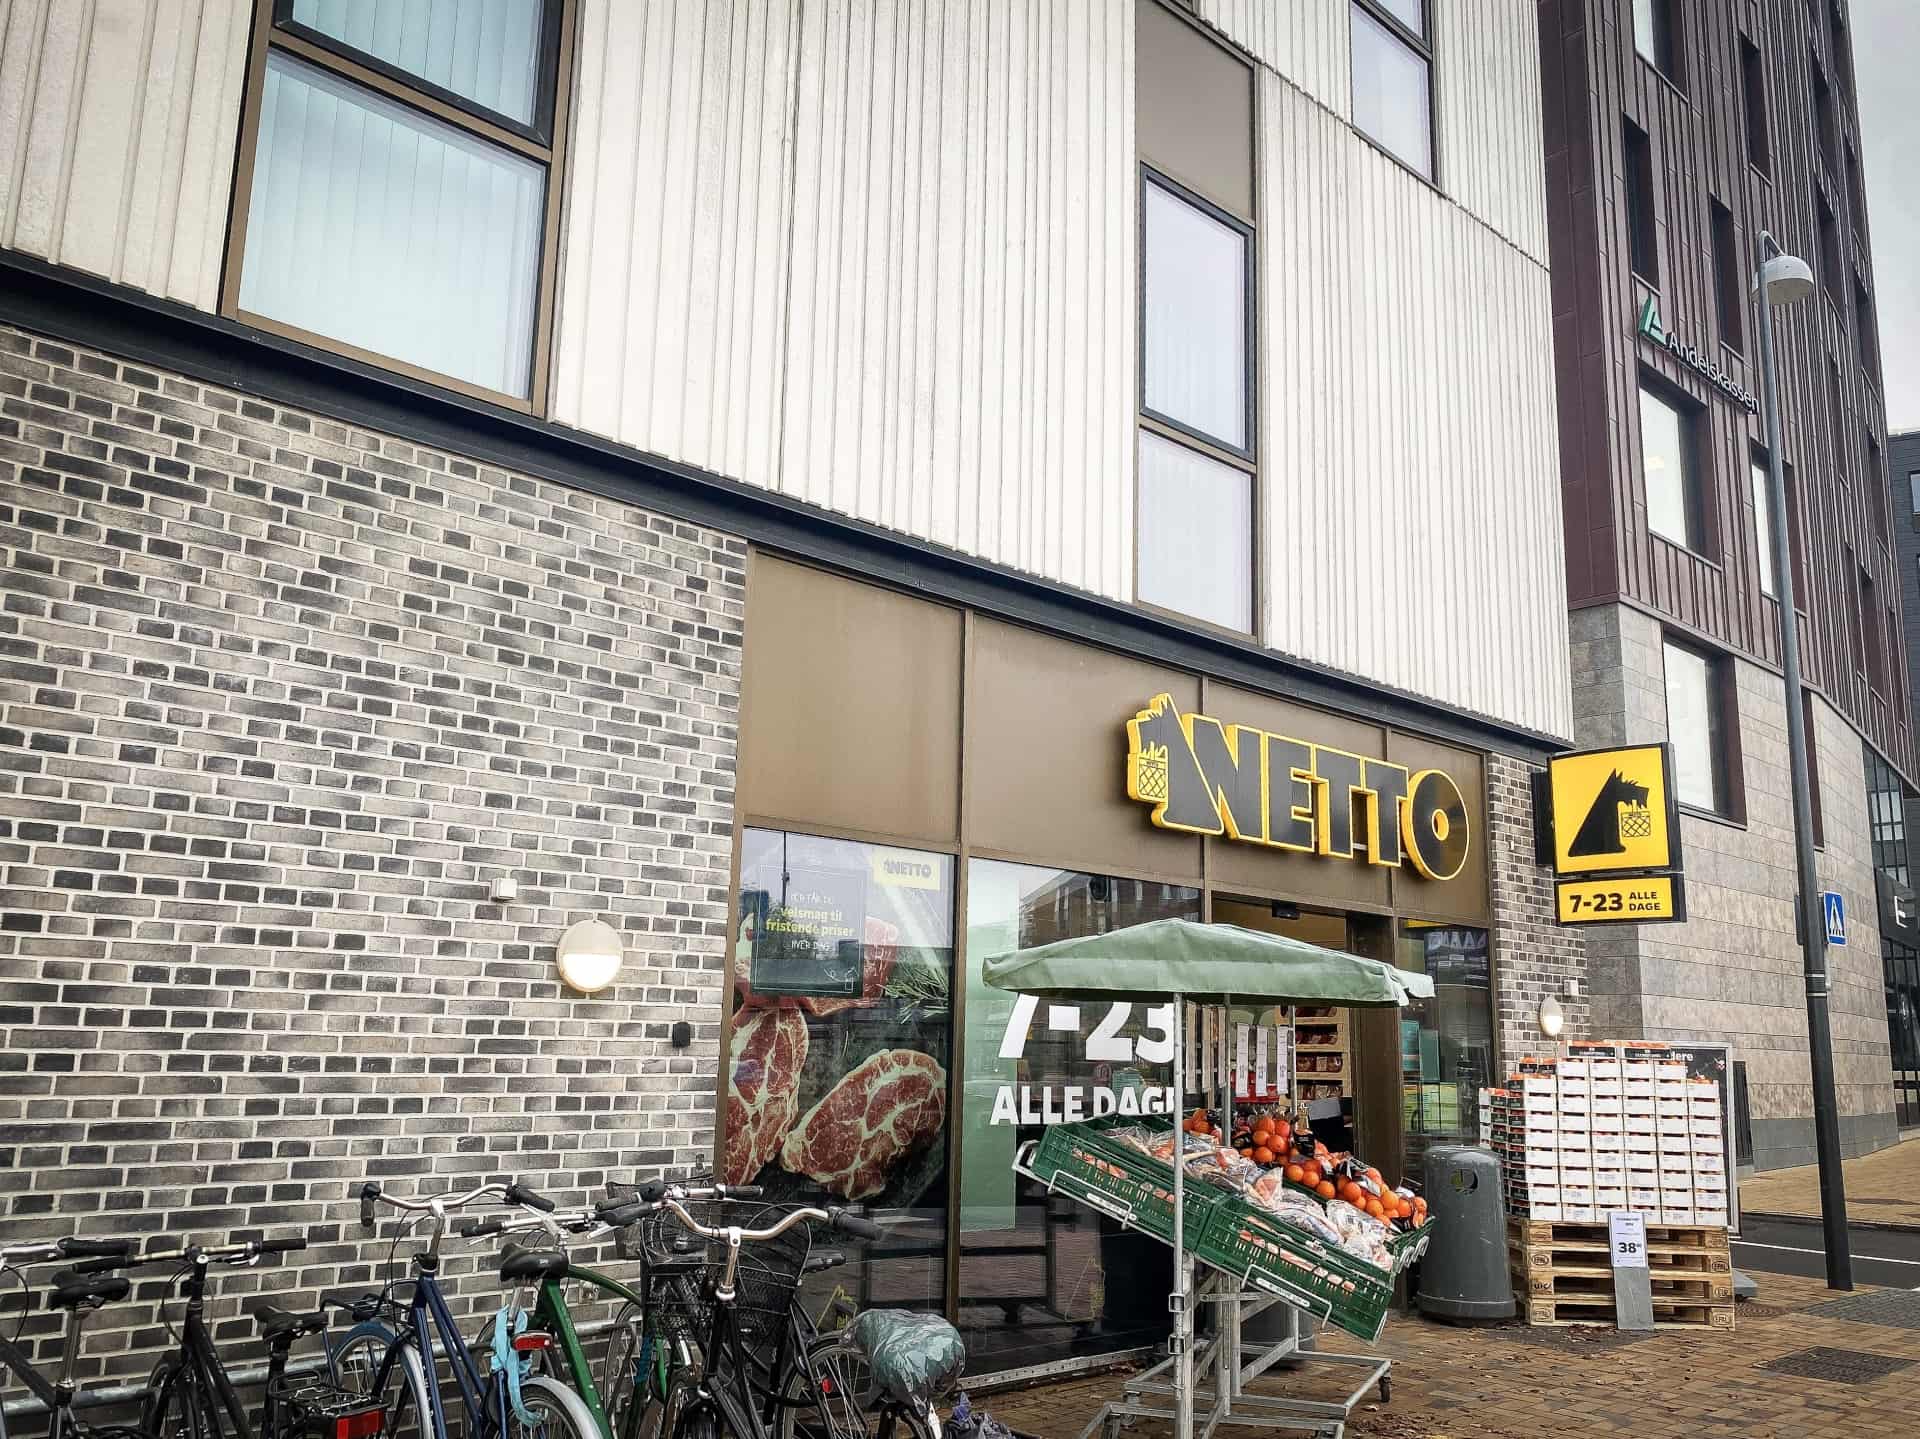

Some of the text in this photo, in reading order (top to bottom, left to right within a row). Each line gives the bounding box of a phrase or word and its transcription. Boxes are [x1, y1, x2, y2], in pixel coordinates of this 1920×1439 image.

[1668, 331, 1759, 414] Andelskassen
[1172, 710, 1470, 880] NETTO
[885, 860, 932, 878] NETTO
[1569, 892, 1624, 913] 7-23
[1629, 891, 1657, 900] ALLE
[1629, 903, 1661, 911] DAGE
[989, 1086, 1084, 1125] ALLE
